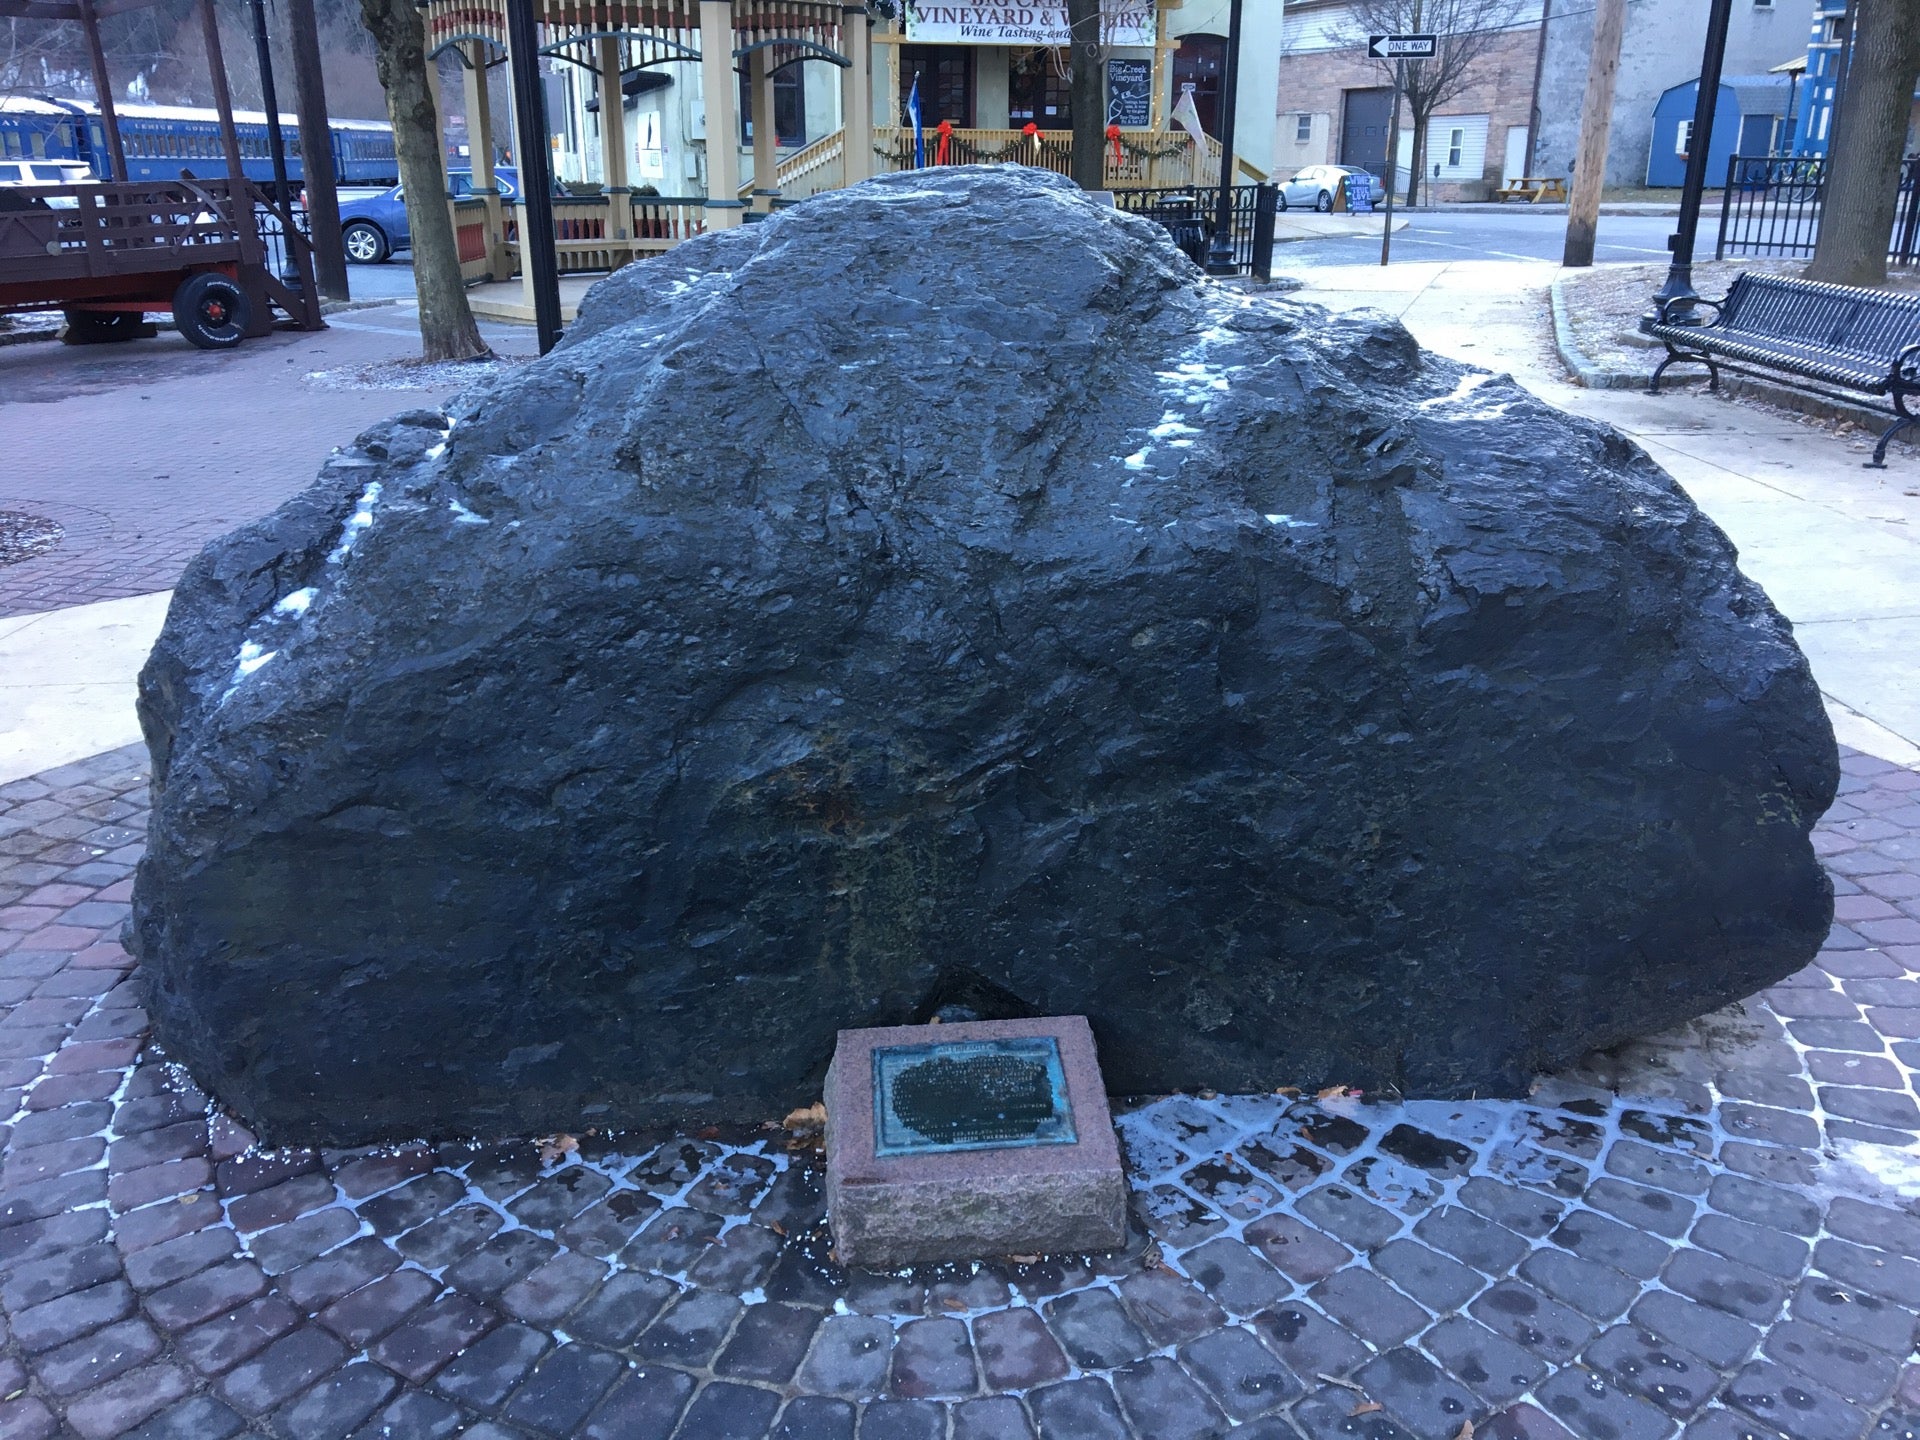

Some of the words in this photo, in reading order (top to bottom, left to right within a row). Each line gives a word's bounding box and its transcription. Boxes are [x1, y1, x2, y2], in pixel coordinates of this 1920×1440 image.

[915, 7, 1034, 26] VINEYARD
[1040, 10, 1054, 26] &
[961, 25, 993, 37] Wine
[999, 25, 1043, 42] Tasting
[1388, 41, 1407, 51] ONE
[1411, 41, 1430, 51] WAY
[1110, 73, 1143, 84] Vineyard
